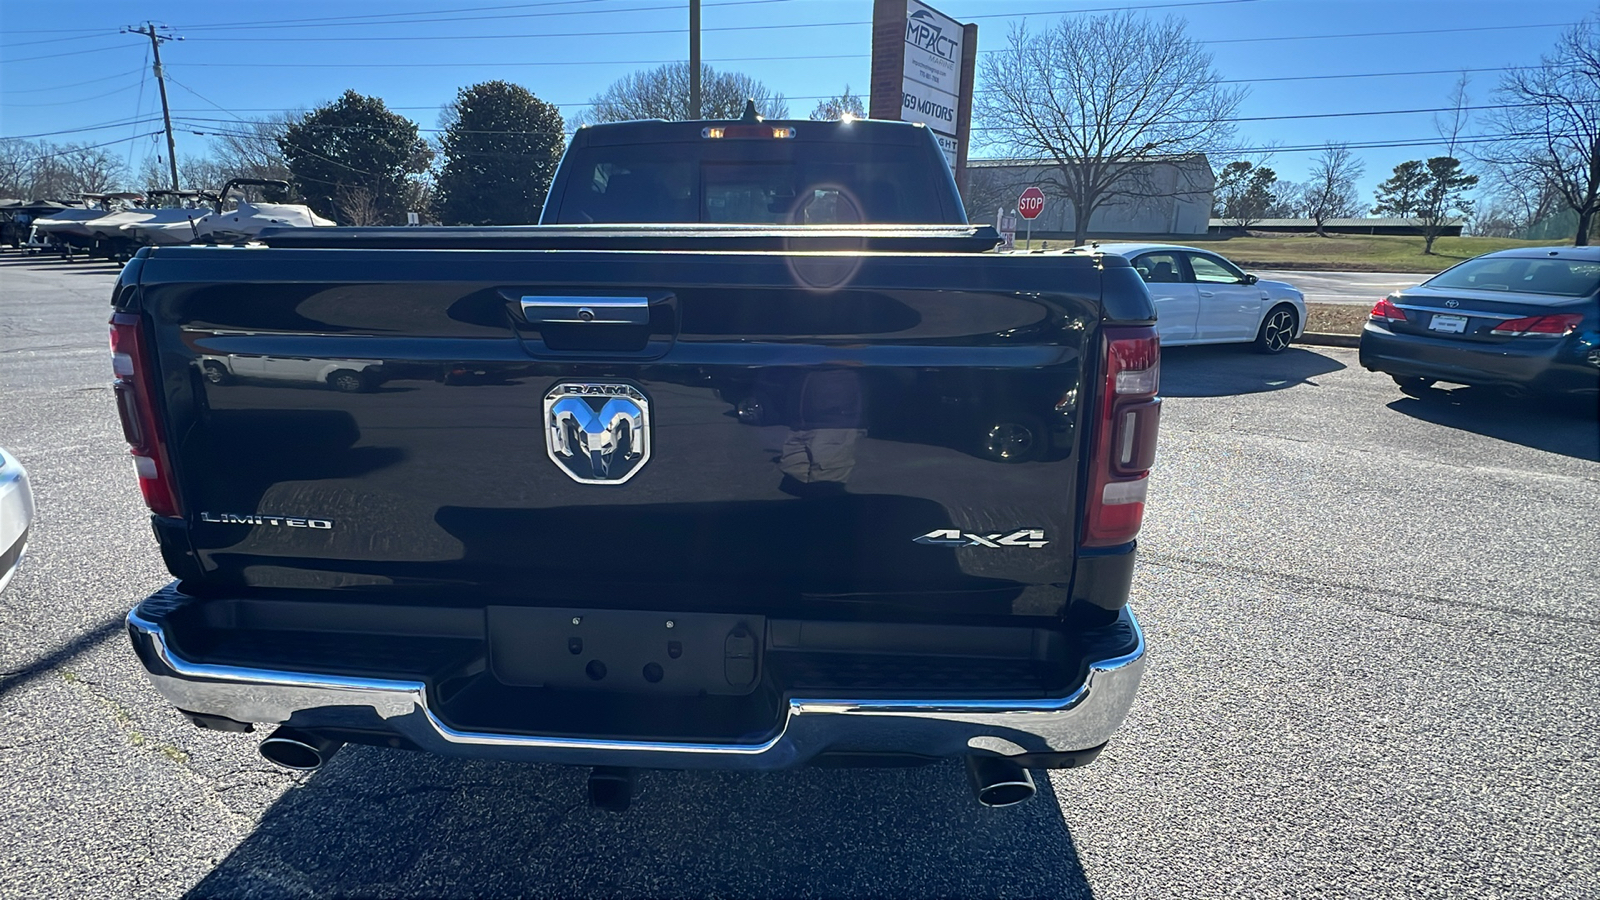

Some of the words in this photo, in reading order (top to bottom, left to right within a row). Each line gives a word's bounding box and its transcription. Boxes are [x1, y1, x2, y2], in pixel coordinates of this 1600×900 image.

[905, 19, 958, 59] MPACT
[928, 55, 954, 71] MARINE
[917, 98, 954, 122] MOTORS
[1020, 197, 1043, 210] STOP
[564, 384, 627, 396] RAM
[200, 511, 334, 530] LIMITED
